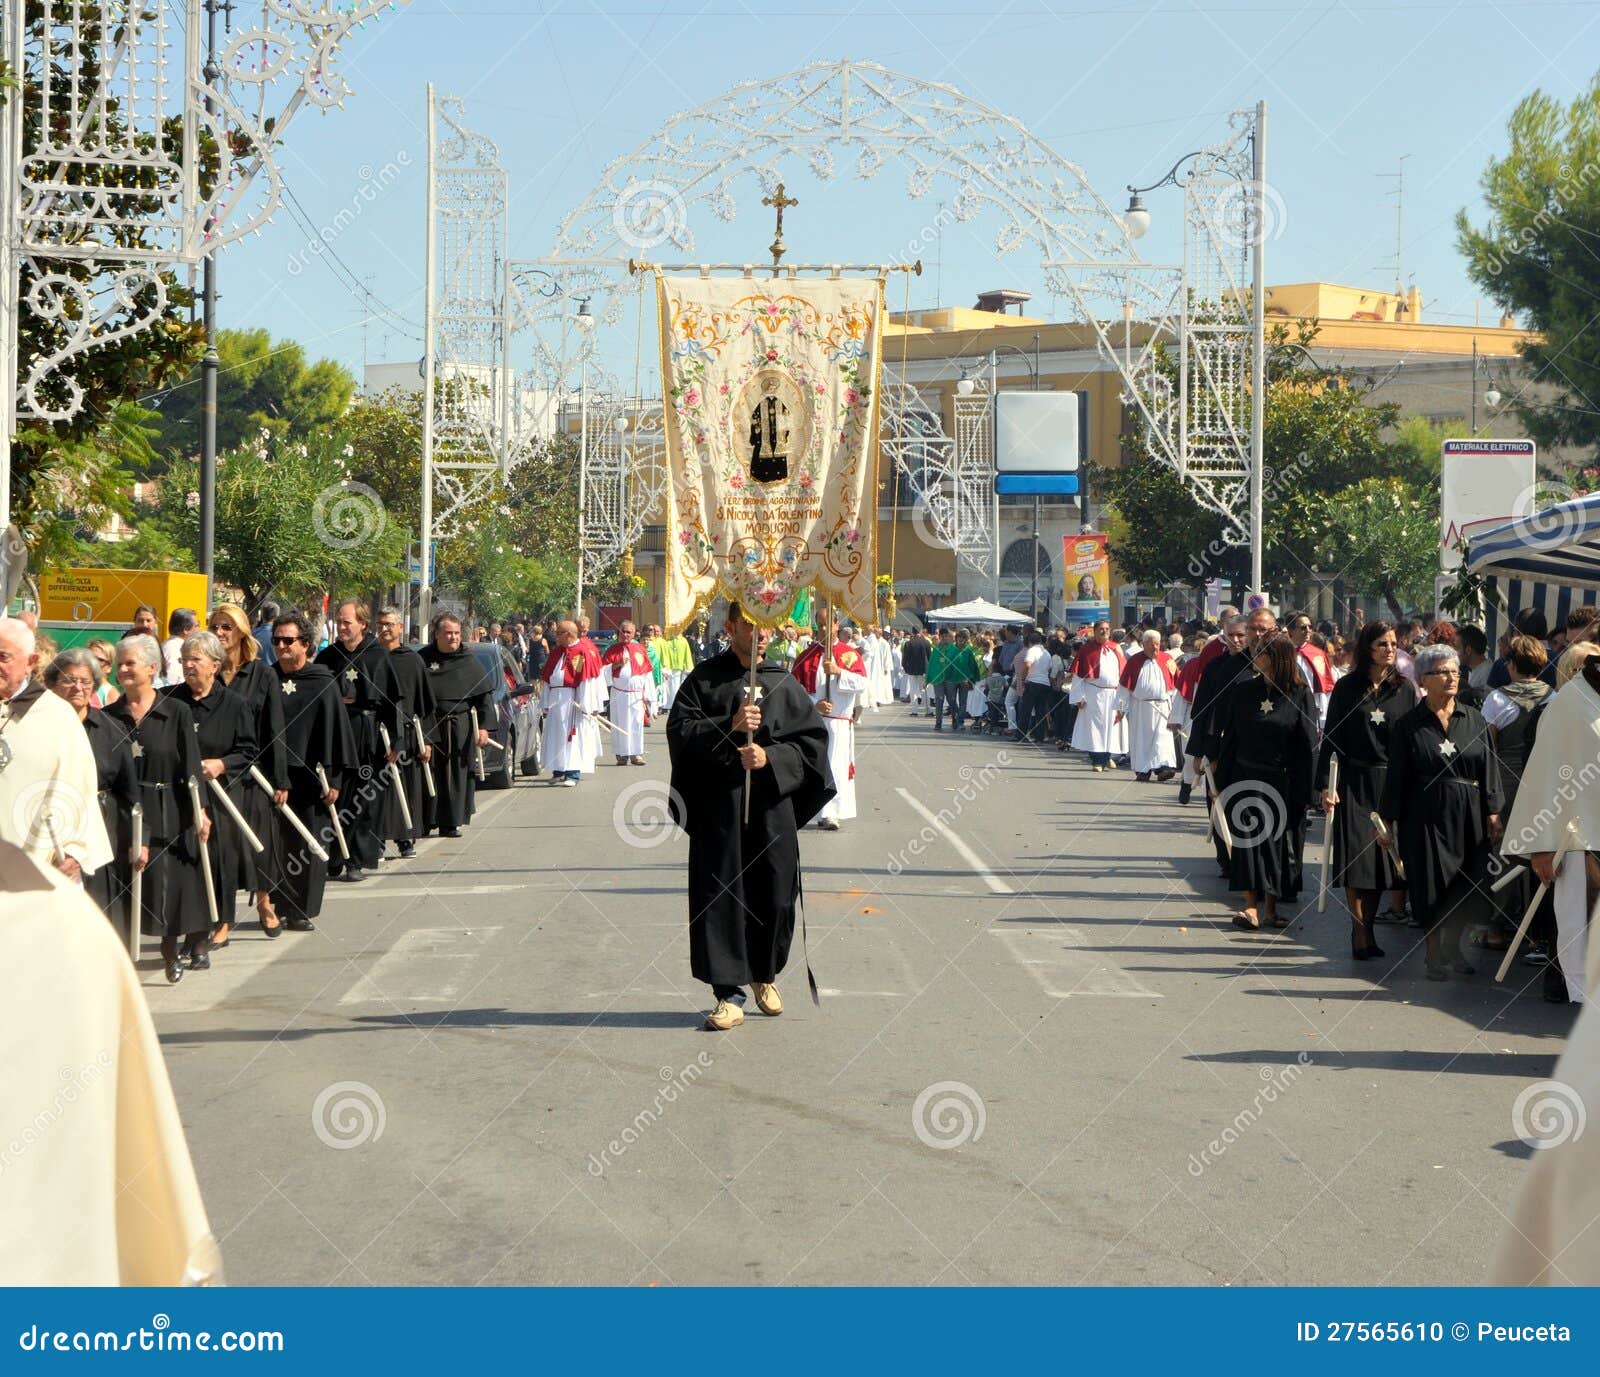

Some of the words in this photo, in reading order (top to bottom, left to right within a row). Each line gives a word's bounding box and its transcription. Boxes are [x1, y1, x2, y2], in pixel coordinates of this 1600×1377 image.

[1449, 443, 1488, 451] MATERIALE
[1490, 443, 1529, 451] ELETTRICO
[769, 496, 821, 506] AGOSTINIANO
[763, 510, 775, 520] DA
[776, 505, 823, 521] TOLENTINO
[745, 522, 801, 535] MODUGNO
[48, 585, 100, 593] DIFFERENZIATA
